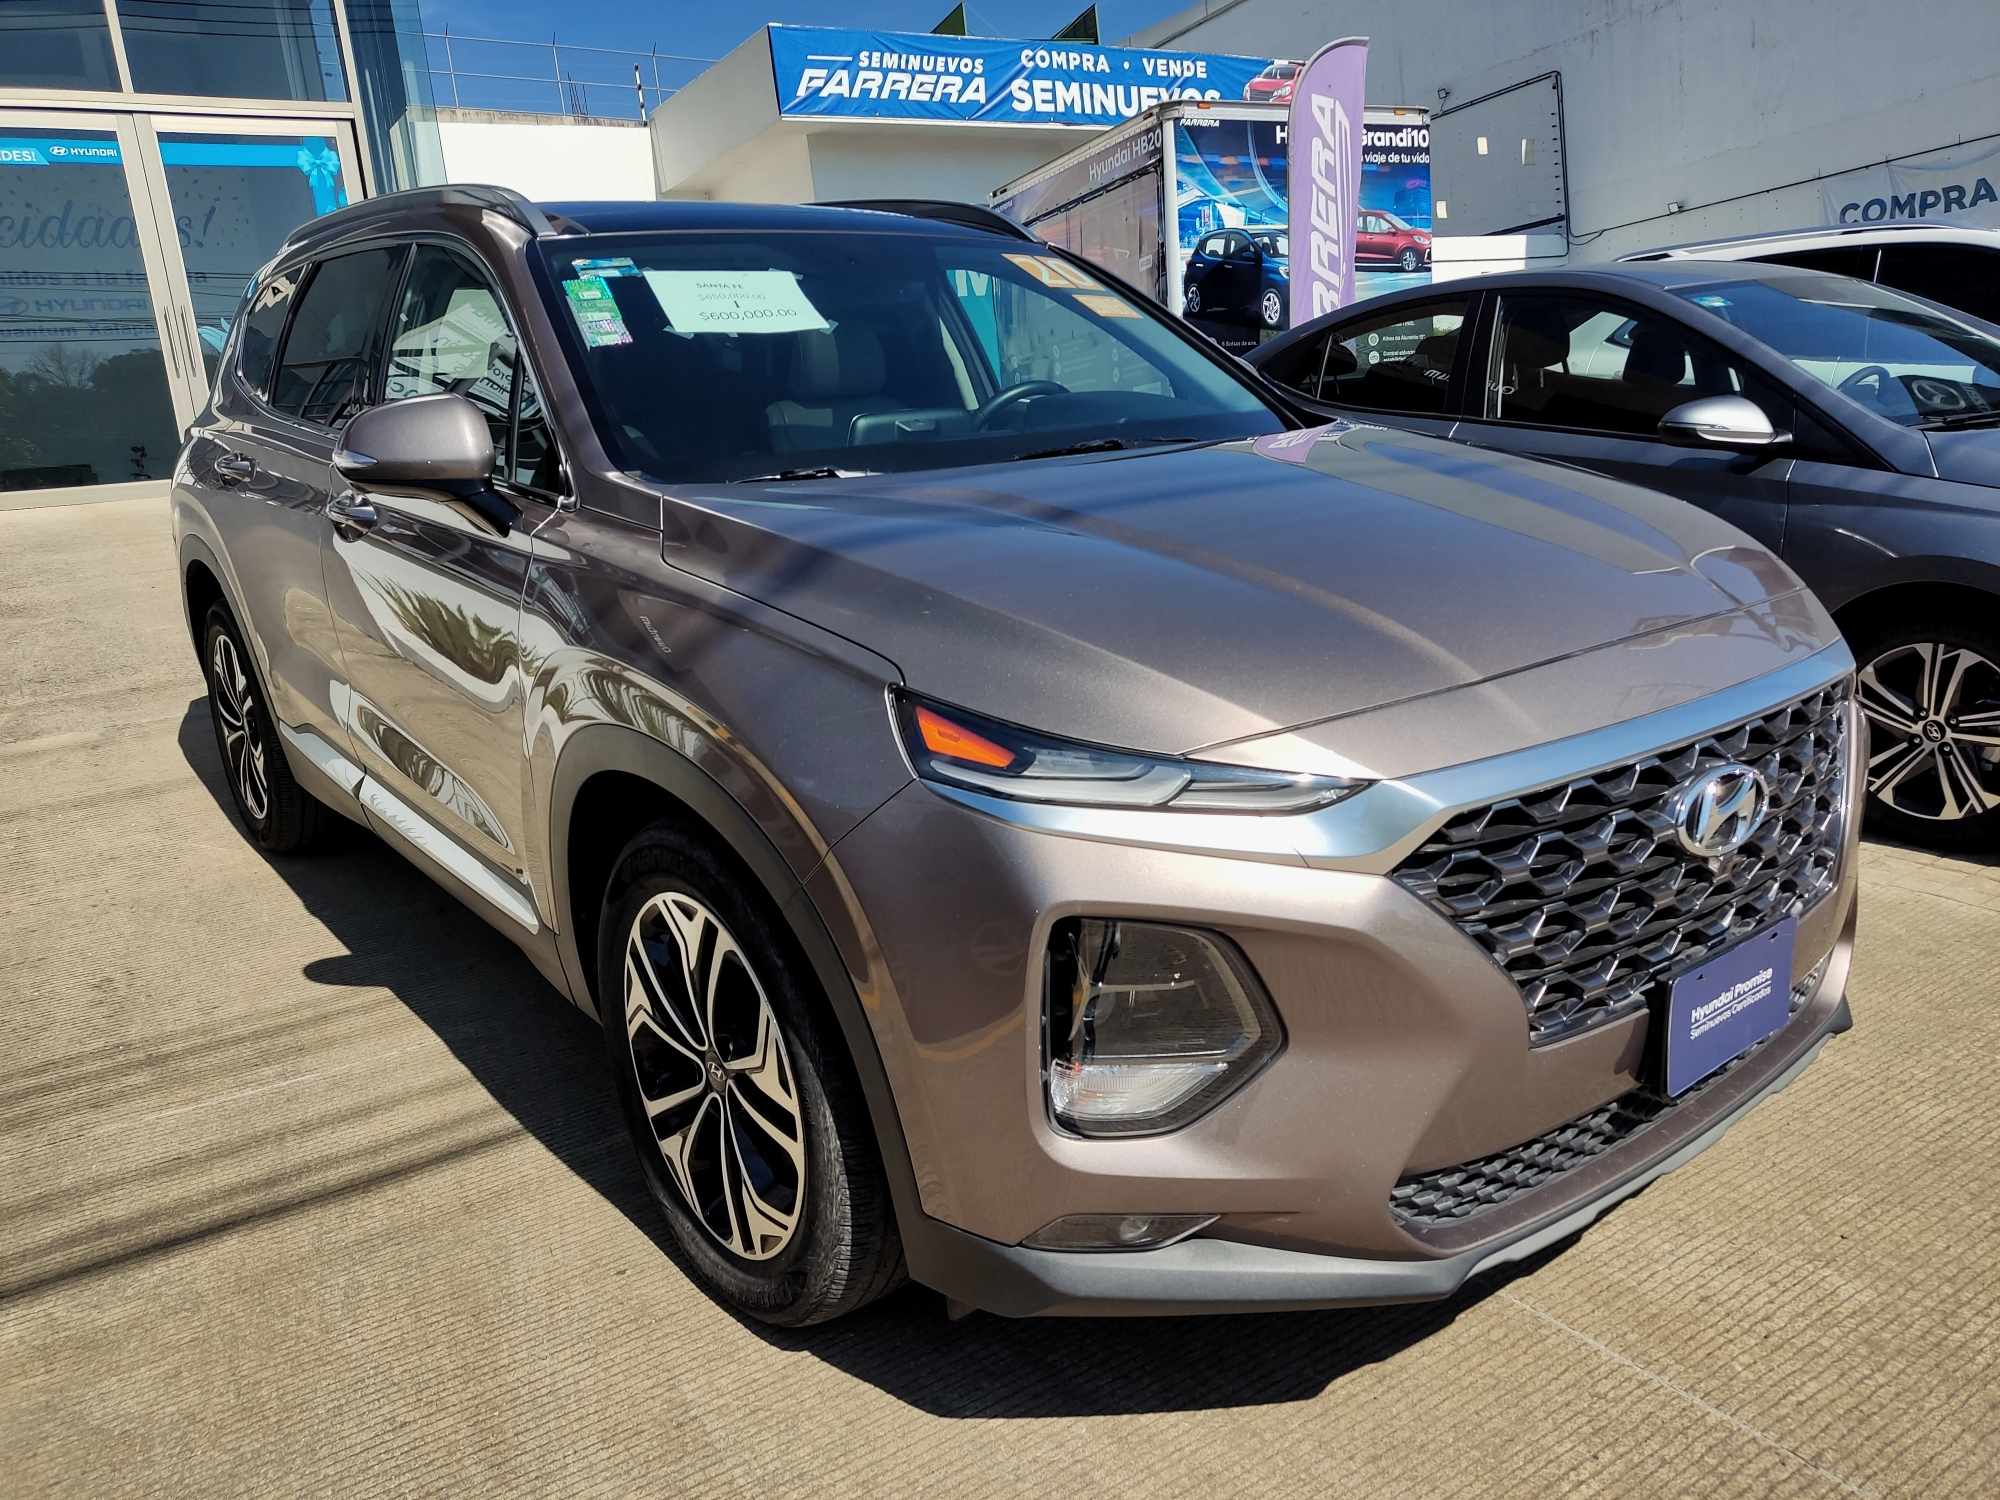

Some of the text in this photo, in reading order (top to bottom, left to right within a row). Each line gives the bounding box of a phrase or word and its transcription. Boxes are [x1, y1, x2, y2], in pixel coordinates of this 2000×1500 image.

[859, 50, 984, 74] SEMINUEVOS
[1020, 49, 1208, 79] COMPRA VENDE
[796, 68, 986, 104] FARRERA
[0, 149, 36, 162] DES!
[70, 147, 118, 158] HYUNDAI
[1089, 128, 1162, 182] Hyundai HB20
[1364, 152, 1430, 165] viaje de tu vida
[1839, 177, 1998, 224] COMPRA
[699, 308, 797, 321] $600,000.00
[1691, 968, 1773, 1023] Hyundai Promise
